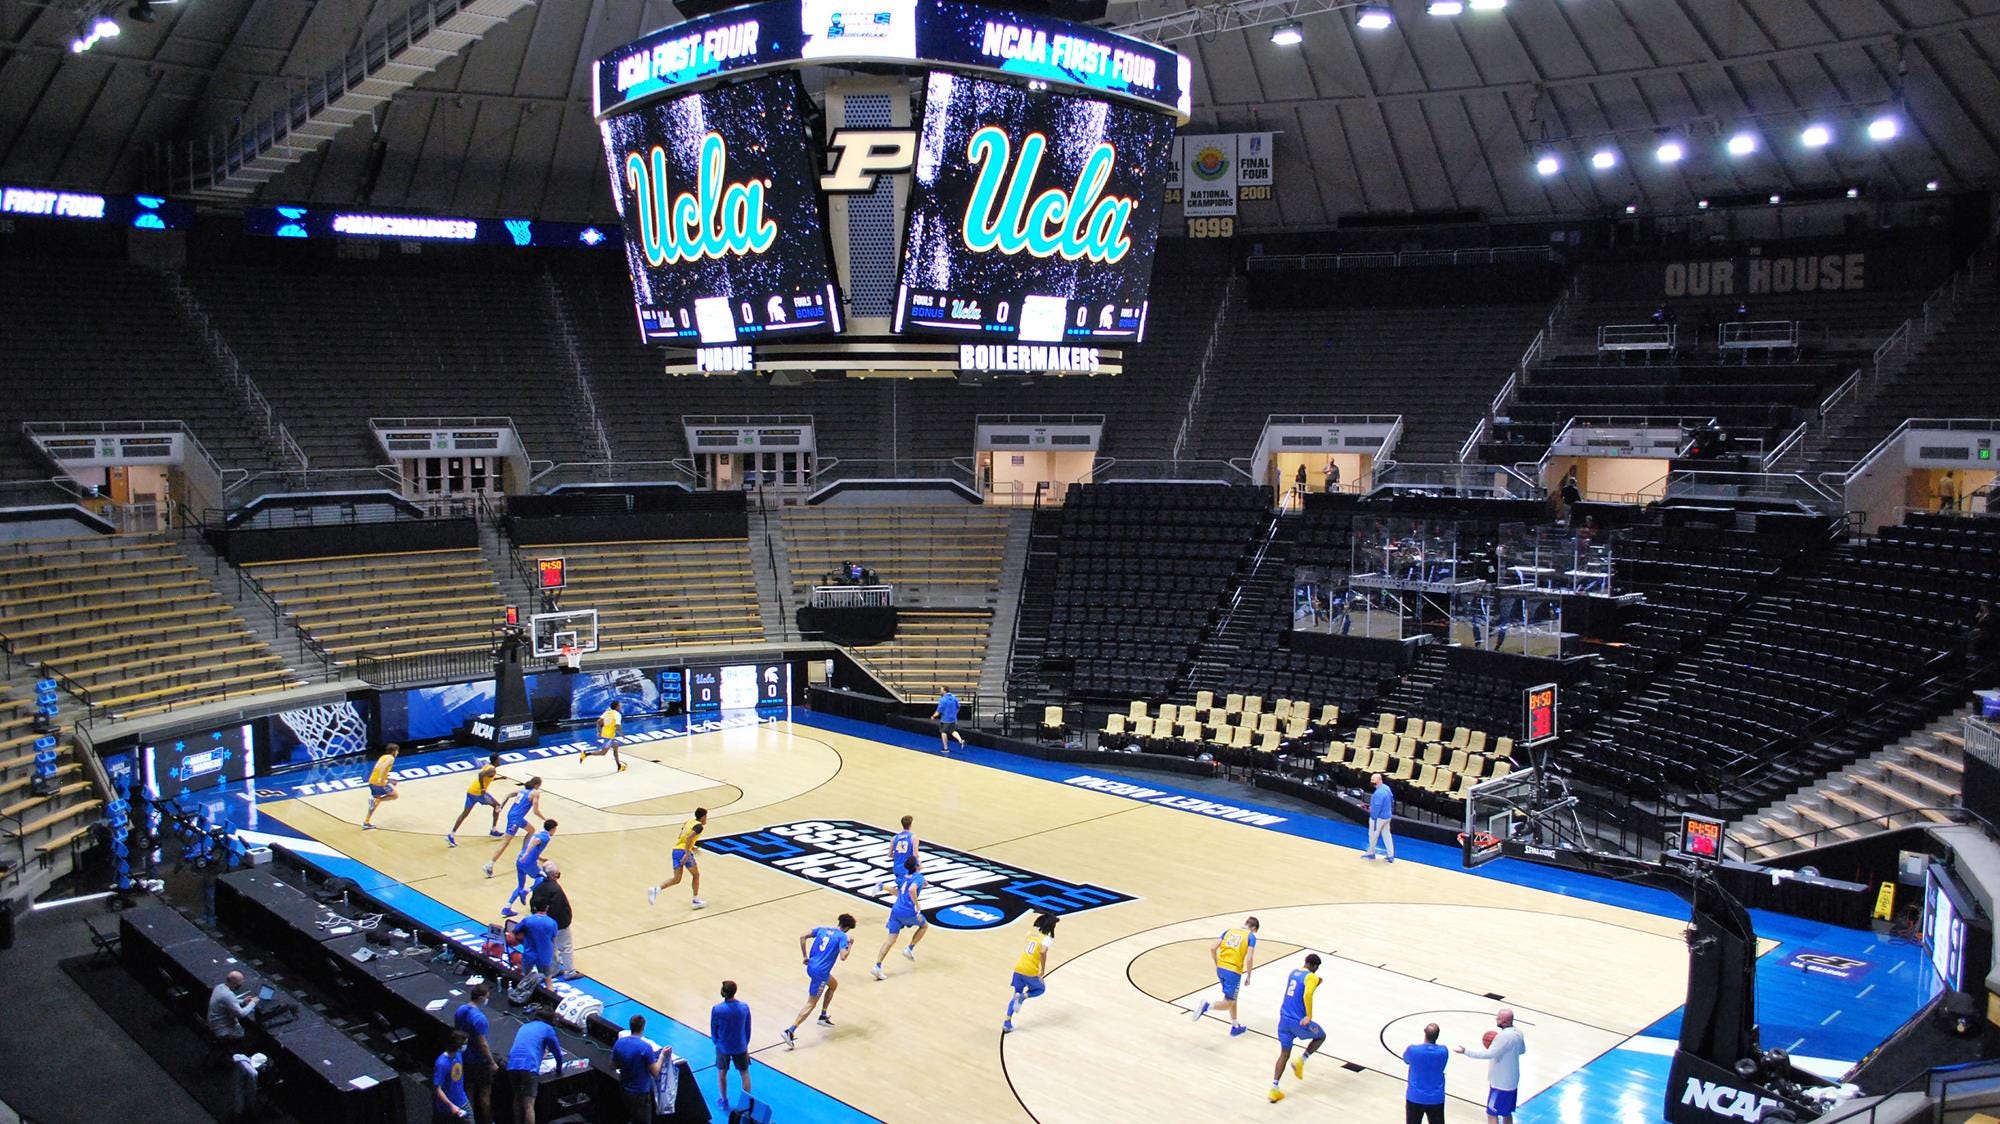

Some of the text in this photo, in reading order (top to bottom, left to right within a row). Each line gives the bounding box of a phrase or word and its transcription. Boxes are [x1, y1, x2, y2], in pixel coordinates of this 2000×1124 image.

[652, 34, 702, 78] FIRST
[703, 20, 759, 64] FOUR
[981, 22, 1156, 90] NCAA FIRST FOUR
[820, 128, 917, 190] P
[1241, 158, 1270, 168] FINAL
[1242, 169, 1268, 179] FOUR
[2, 187, 105, 218] FIRST FOUR
[1187, 198, 1234, 208] CHAMPIONS
[1190, 190, 1230, 199] NATIONAL
[1240, 187, 1271, 200] 2001
[1187, 217, 1233, 239] 1999
[1664, 253, 1865, 297] OUR HOUSE
[912, 294, 933, 307] FOULS
[680, 308, 690, 329] 0
[741, 302, 753, 324] 0
[795, 307, 825, 319] BONUS
[911, 307, 944, 318] BONUS
[996, 301, 1009, 323] 0
[1076, 306, 1087, 327] 0
[697, 346, 753, 371] PURDUE
[959, 344, 1100, 371] BOILERMAKERS
[702, 688, 711, 701] 0
[768, 684, 777, 697] 0
[471, 721, 496, 740] NCAA
[292, 775, 370, 795] THE
[528, 741, 597, 757] THE
[1064, 775, 1288, 825] ARENA MACKEY
[1524, 845, 1556, 859] SPALDING
[950, 905, 1001, 922] NCAA
[819, 936, 830, 951] 3
[1286, 979, 1297, 997] 2
